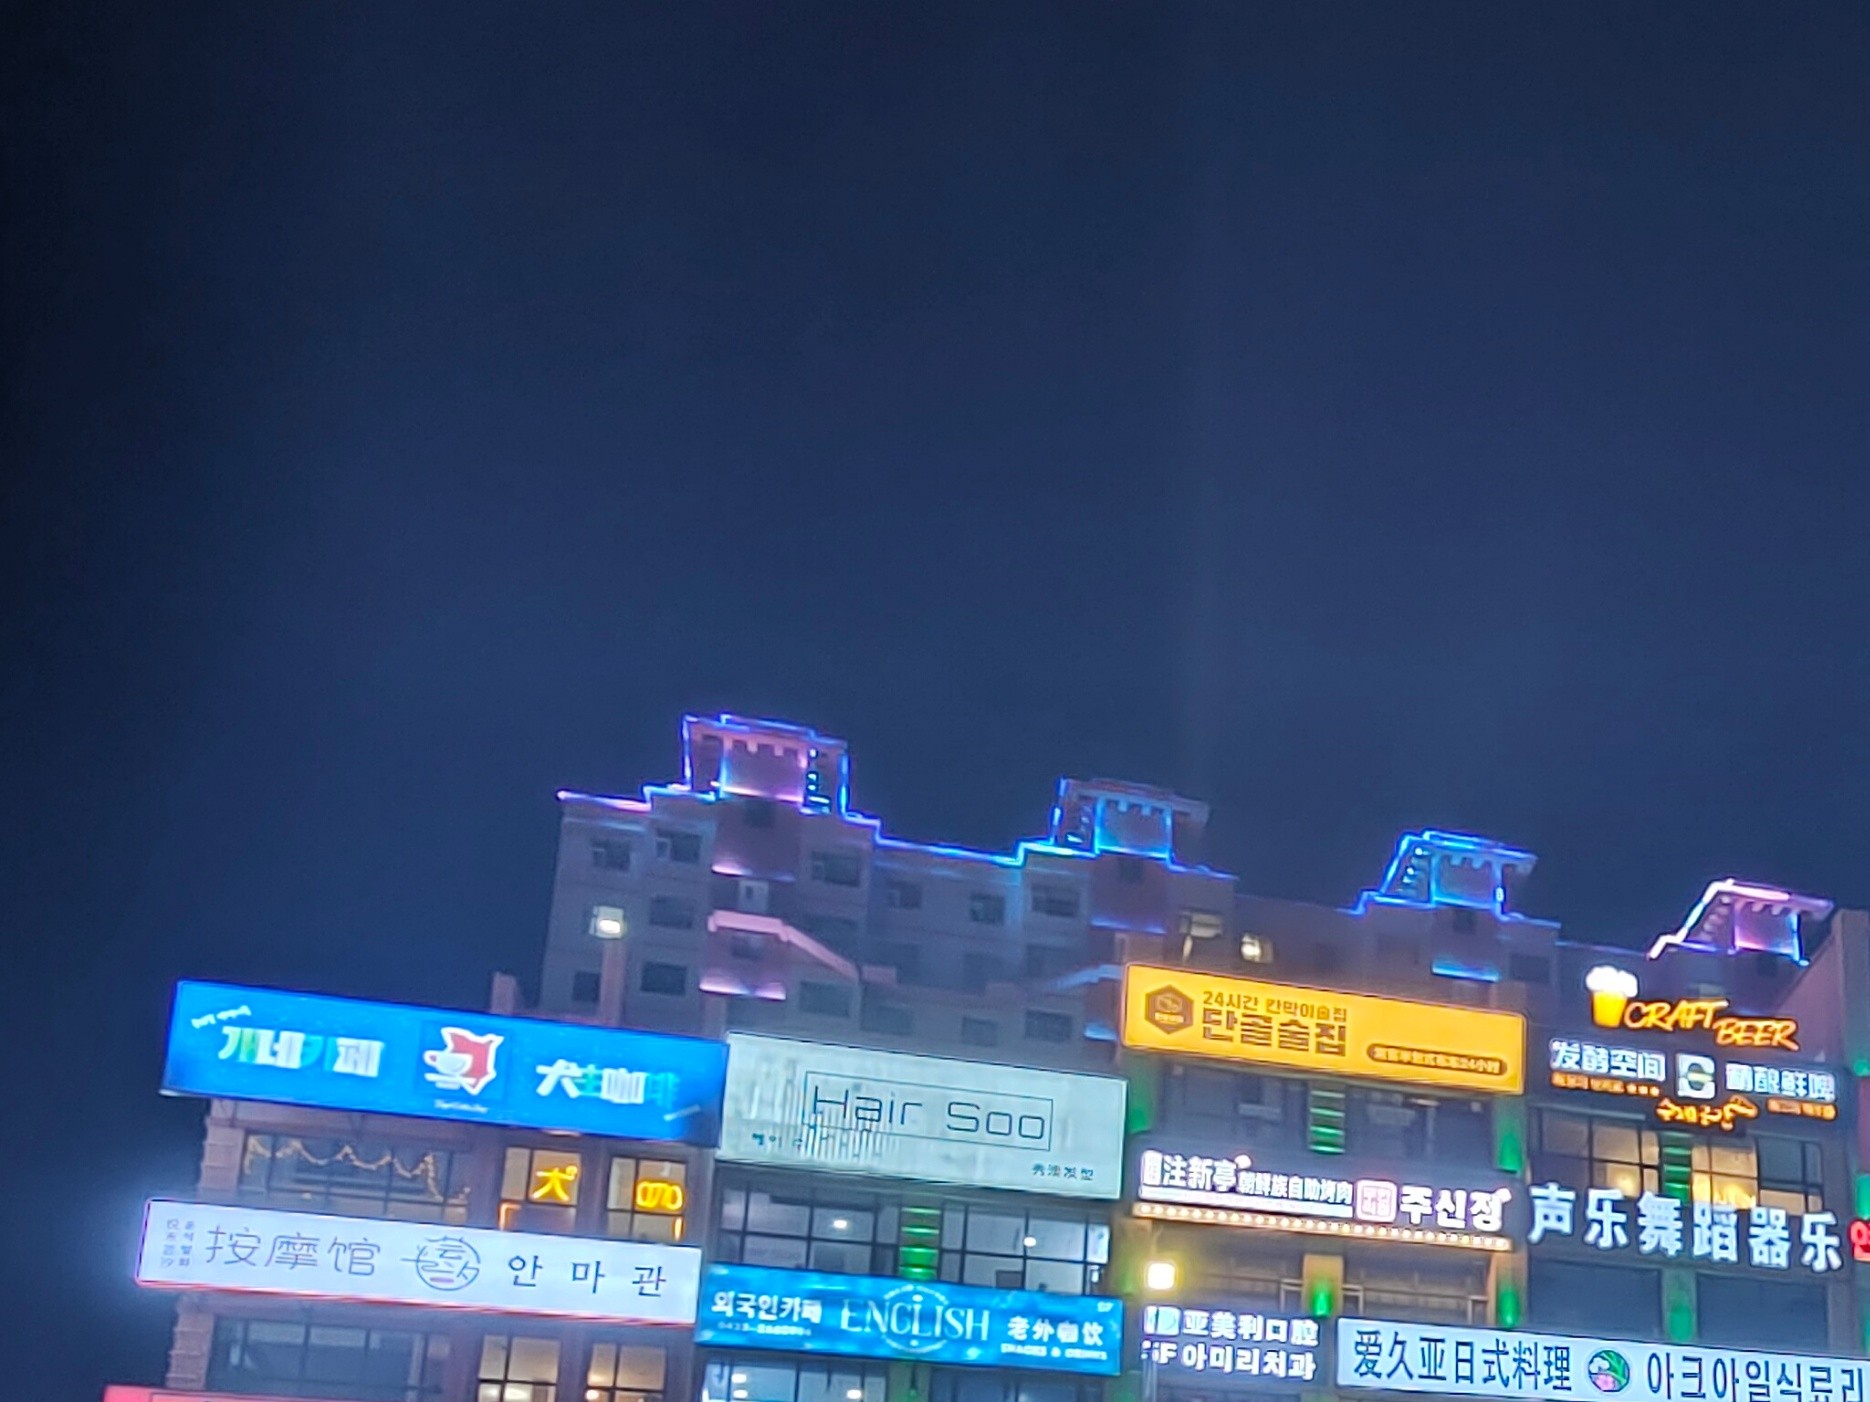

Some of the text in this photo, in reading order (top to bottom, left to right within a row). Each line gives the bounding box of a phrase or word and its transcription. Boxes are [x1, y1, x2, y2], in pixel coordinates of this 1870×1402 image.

[1203, 990, 1259, 1011] 24시간
[1623, 997, 1799, 1051] CRAFT BEER
[1202, 1007, 1347, 1057] 단골술집
[812, 1085, 1047, 1141] Hair Soo
[1400, 1185, 1503, 1232] 주신정
[1528, 1182, 1843, 1272] 声乐舞蹈器乐
[205, 1225, 382, 1276] 按摩馆
[711, 1290, 822, 1325] 외국인카페
[840, 1299, 990, 1343] ENGLISH
[1182, 1309, 1320, 1348] 亚美利口腔
[1183, 1343, 1318, 1381] 아미리치과
[1353, 1328, 1572, 1392] 爱久亚日式料理
